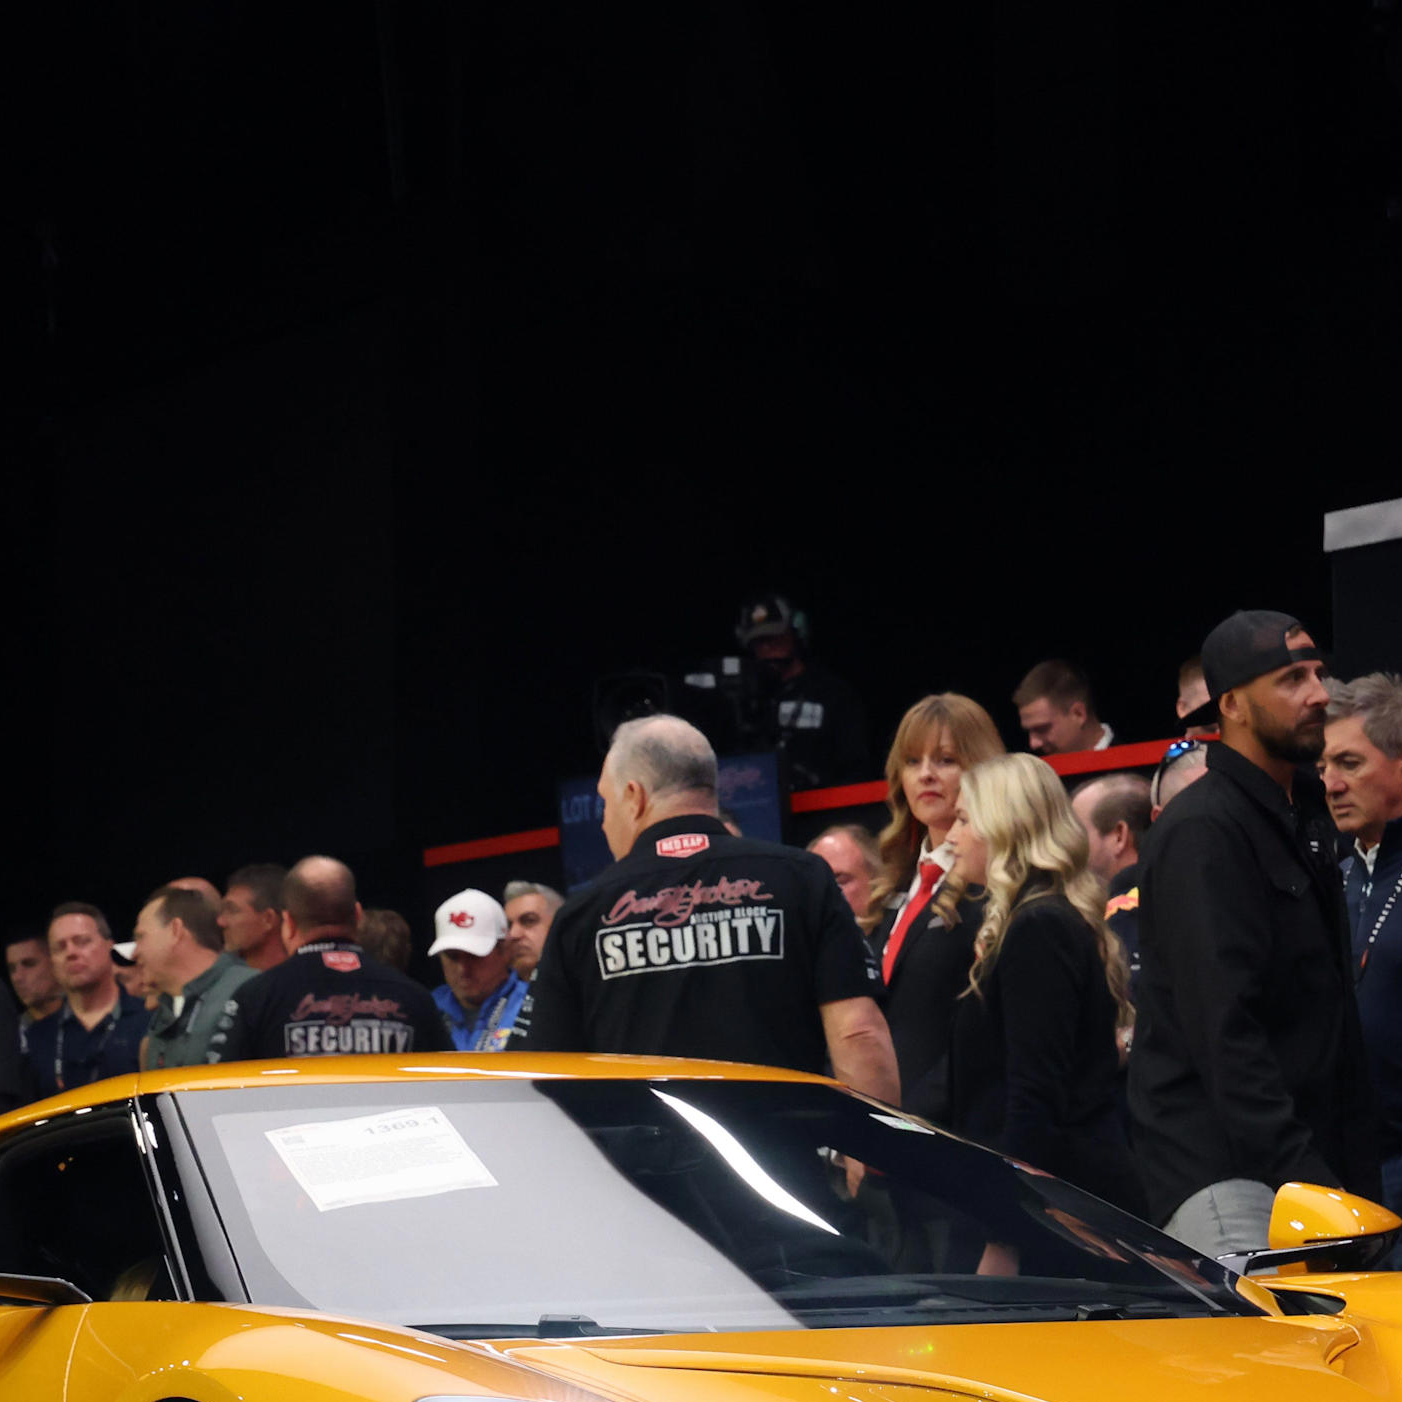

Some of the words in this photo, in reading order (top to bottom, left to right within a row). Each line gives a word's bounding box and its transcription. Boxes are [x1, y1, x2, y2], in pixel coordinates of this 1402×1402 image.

[602, 916, 777, 973] SECURITY
[290, 1022, 409, 1054] SECURITY
[364, 1115, 440, 1136] 1369.1
